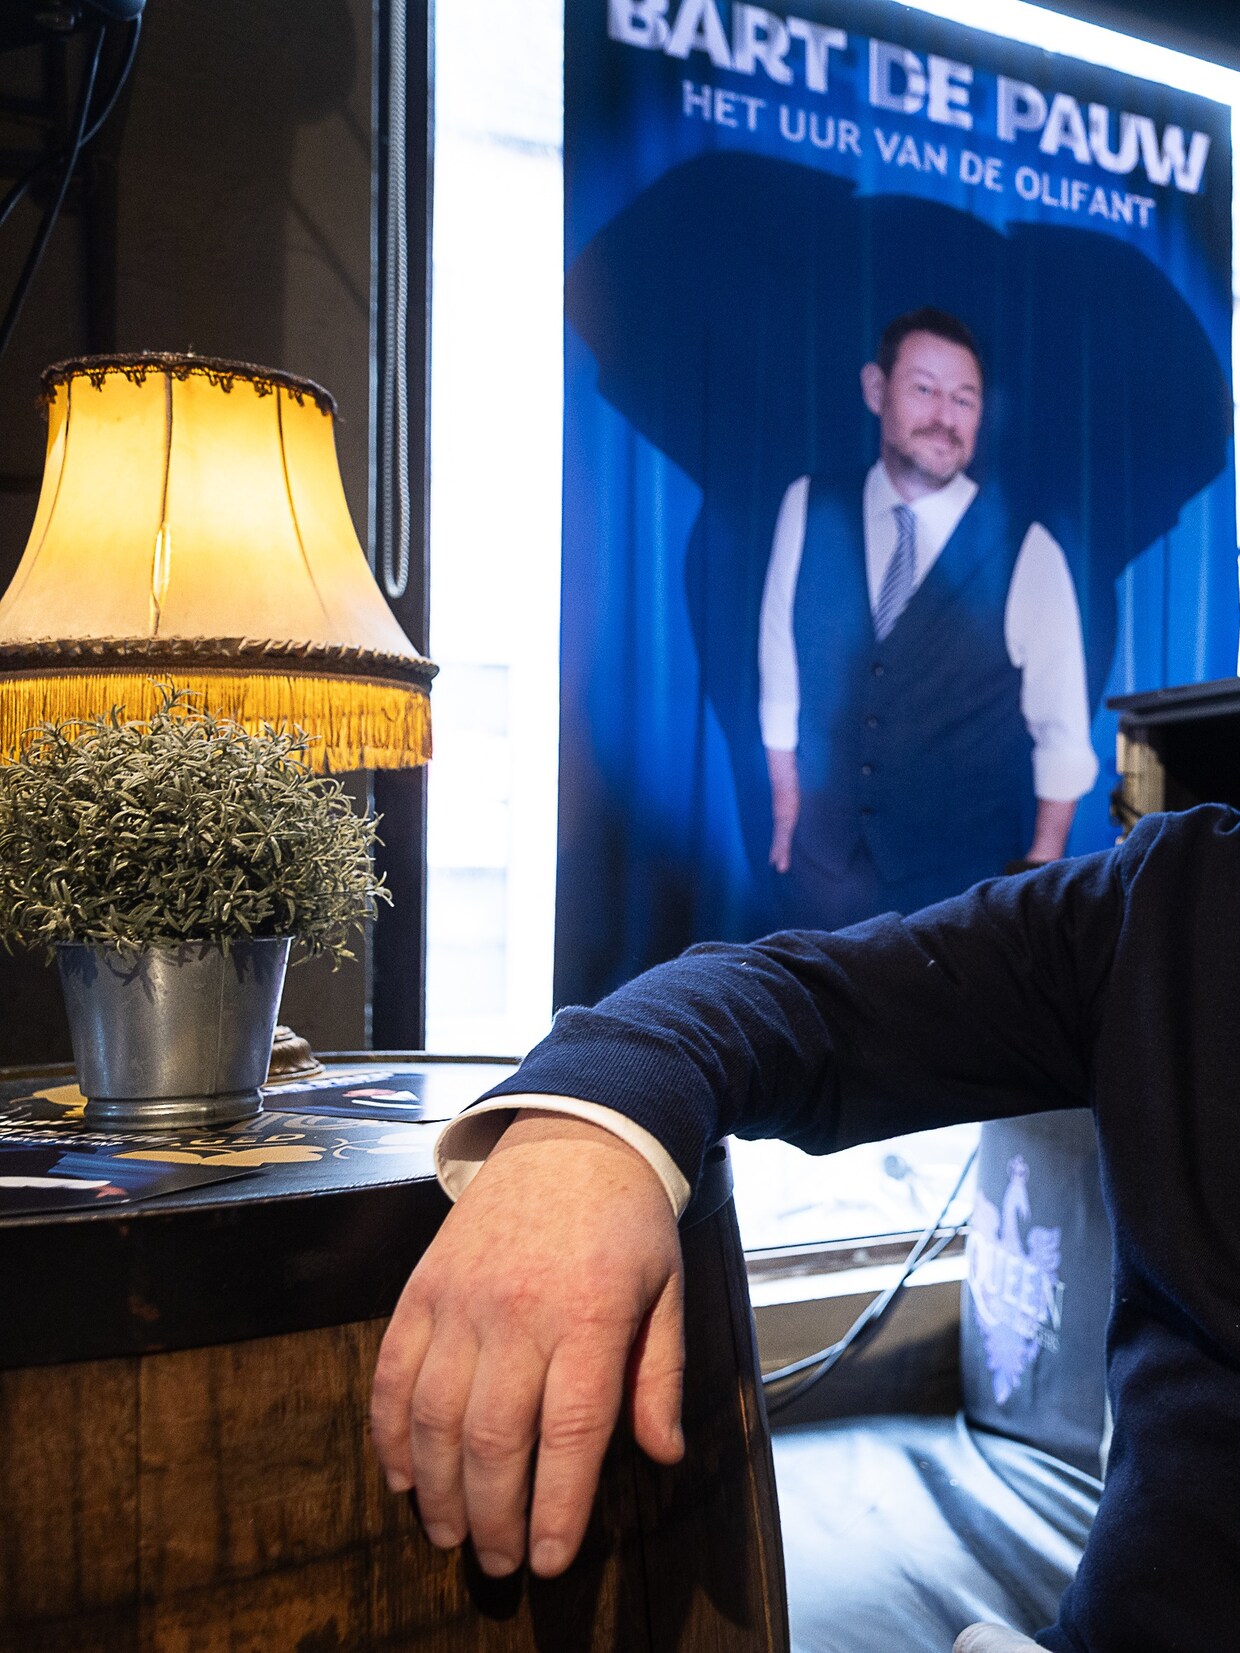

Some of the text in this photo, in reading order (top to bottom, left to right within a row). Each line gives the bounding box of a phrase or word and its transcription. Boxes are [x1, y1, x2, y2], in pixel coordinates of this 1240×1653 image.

[608, 0, 1211, 194] BART DE PAUW
[683, 79, 1156, 229] HET UUR VAN DE OLIFANT
